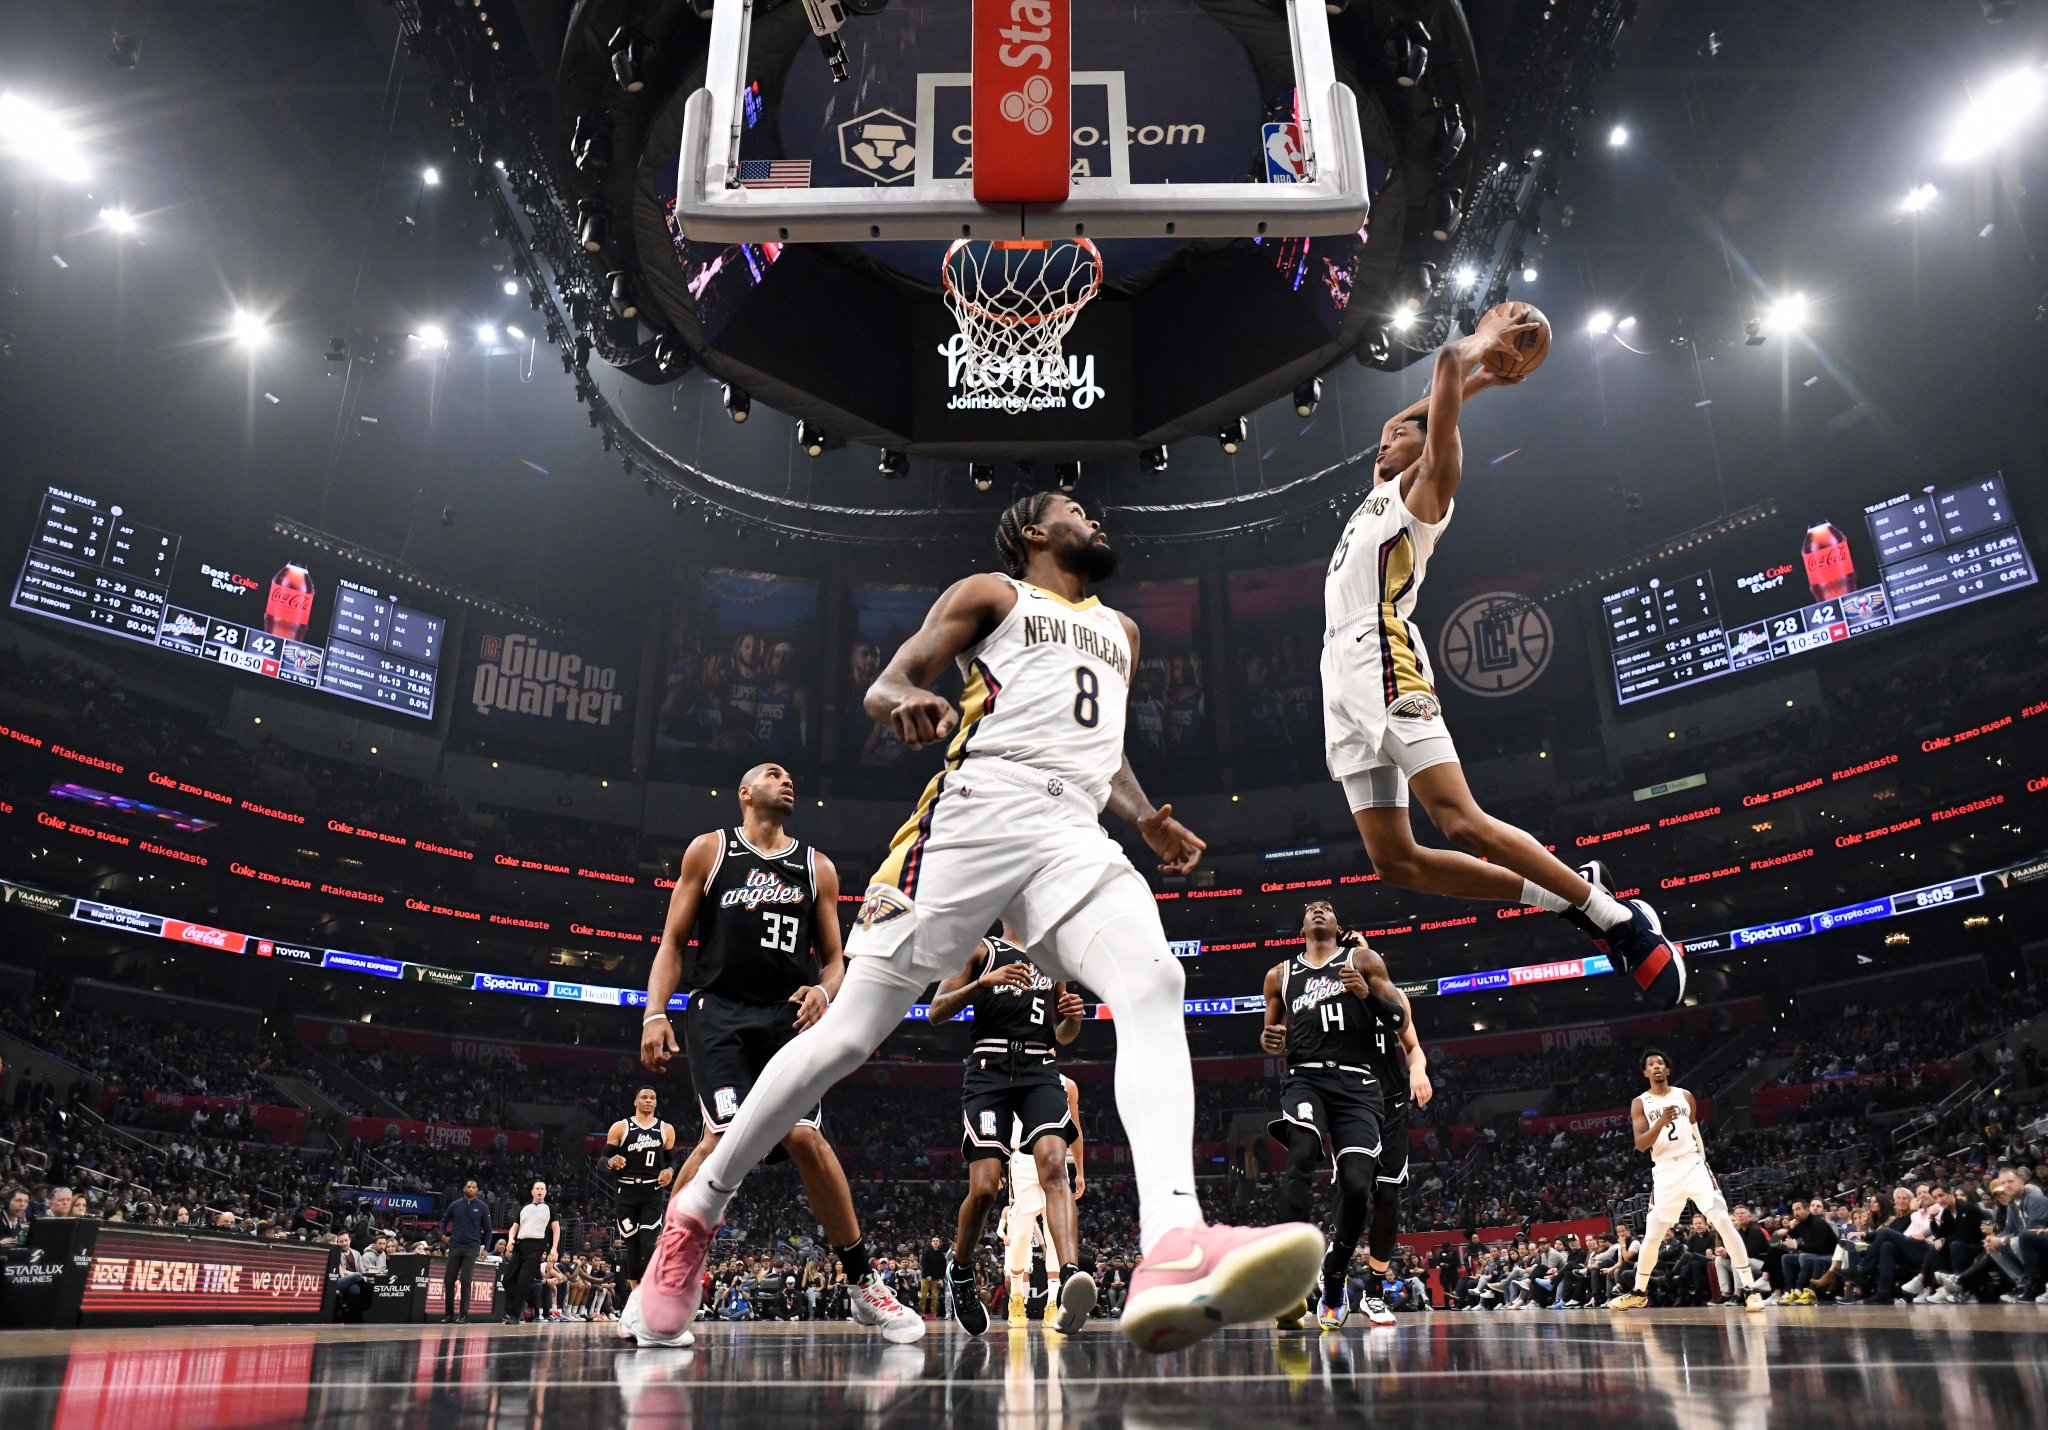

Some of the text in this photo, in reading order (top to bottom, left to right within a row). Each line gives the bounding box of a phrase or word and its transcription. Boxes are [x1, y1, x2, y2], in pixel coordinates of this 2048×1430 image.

[937, 333, 1105, 410] honey
[48, 486, 97, 507] TEAM STATS
[201, 563, 259, 590] Best Coke
[1737, 564, 1793, 589] Best Coke
[1751, 575, 1784, 594] Ever?
[134, 588, 163, 604] 50.0%
[211, 578, 246, 597] Ever?
[130, 604, 160, 619] 30.0%
[1811, 606, 1836, 624] 42
[126, 620, 156, 635] 50.0%
[213, 625, 239, 645] 28
[1023, 615, 1067, 647] NEW
[1773, 617, 1798, 637] 28
[251, 637, 276, 656] 42
[1791, 631, 1829, 648] 10:50
[204, 647, 217, 657] 2nd
[223, 651, 261, 670] 10:50
[501, 633, 617, 691] Give no
[472, 663, 623, 725] Quarter
[1073, 664, 1099, 729] 8
[1921, 716, 2013, 753] Coke ZERO SUGAR
[10, 730, 124, 774] SUGAR #takeataste
[1742, 754, 1899, 807] Coke ZERO SUGAR #takeataste
[148, 771, 305, 824] Coke ZERO SUGAR #takeataste
[1575, 806, 1721, 847] Coke ZERO SUGAR #takeataste
[1834, 794, 2004, 848] Coke ZERO SUGAR #takeataste
[37, 811, 208, 866] Coke ZERO SUGAR #takeataste
[327, 819, 474, 861] Coke ZERO SUGAR #takeataste
[1265, 848, 1321, 859] AMERICAN EXPRESS
[494, 854, 636, 884] Coke ZERO SUGAR #takeataste
[746, 868, 780, 887] los
[1660, 848, 1814, 889] Coke ZERO SUGAR #takeataste
[229, 862, 385, 904] Coke ZERO SUGAR #takeataste
[1260, 882, 1285, 893] Coke
[1285, 881, 1307, 890] ZERO
[1306, 878, 1333, 888] SUGAR
[720, 886, 804, 911] angeles
[1154, 888, 1243, 900] SUGAR #takeataste
[1915, 886, 1955, 906] 8:05
[90, 910, 115, 920] March
[126, 915, 150, 928] Dimes
[405, 898, 550, 930] Coke ZERO SUGAR #takeataste
[1496, 908, 1522, 919] Coke
[1833, 904, 1884, 923] crypto.com
[569, 923, 595, 936] Coke
[595, 929, 617, 938] ZERO
[617, 932, 643, 942] SUGAR
[760, 911, 799, 954] 33
[1365, 916, 1478, 938] ZERO SUGAR #takeataste
[1740, 922, 1802, 944] Spectrum
[275, 946, 311, 960] TOYOTA
[1188, 947, 1195, 955] 6
[1211, 944, 1232, 952] ZERO
[1231, 941, 1257, 950] SUGAR
[1263, 936, 1307, 947] #takeata
[1684, 939, 1720, 953] TOYOTA
[329, 955, 398, 973] AMERICAN EXPRESS
[1512, 961, 1581, 982] TOSHIBA
[482, 976, 539, 993] Spectrum
[1304, 976, 1330, 993] los
[1477, 974, 1507, 986] ULTRA
[556, 988, 616, 1001] UCLA Health
[1291, 979, 1349, 1015] angeles
[1029, 996, 1045, 1026] 5
[1184, 1002, 1229, 1013] DELTA
[1320, 1002, 1345, 1032] 14
[1666, 1121, 1679, 1141] 2
[627, 1138, 662, 1152] angeles
[645, 1150, 656, 1167] 0
[388, 1197, 418, 1209] ULTRA
[4, 1264, 64, 1277] STARLUX
[130, 1259, 320, 1297] NEXEN TIRE we got you
[12, 1276, 53, 1285] AIRLINES
[373, 1285, 411, 1294] STARLUX
